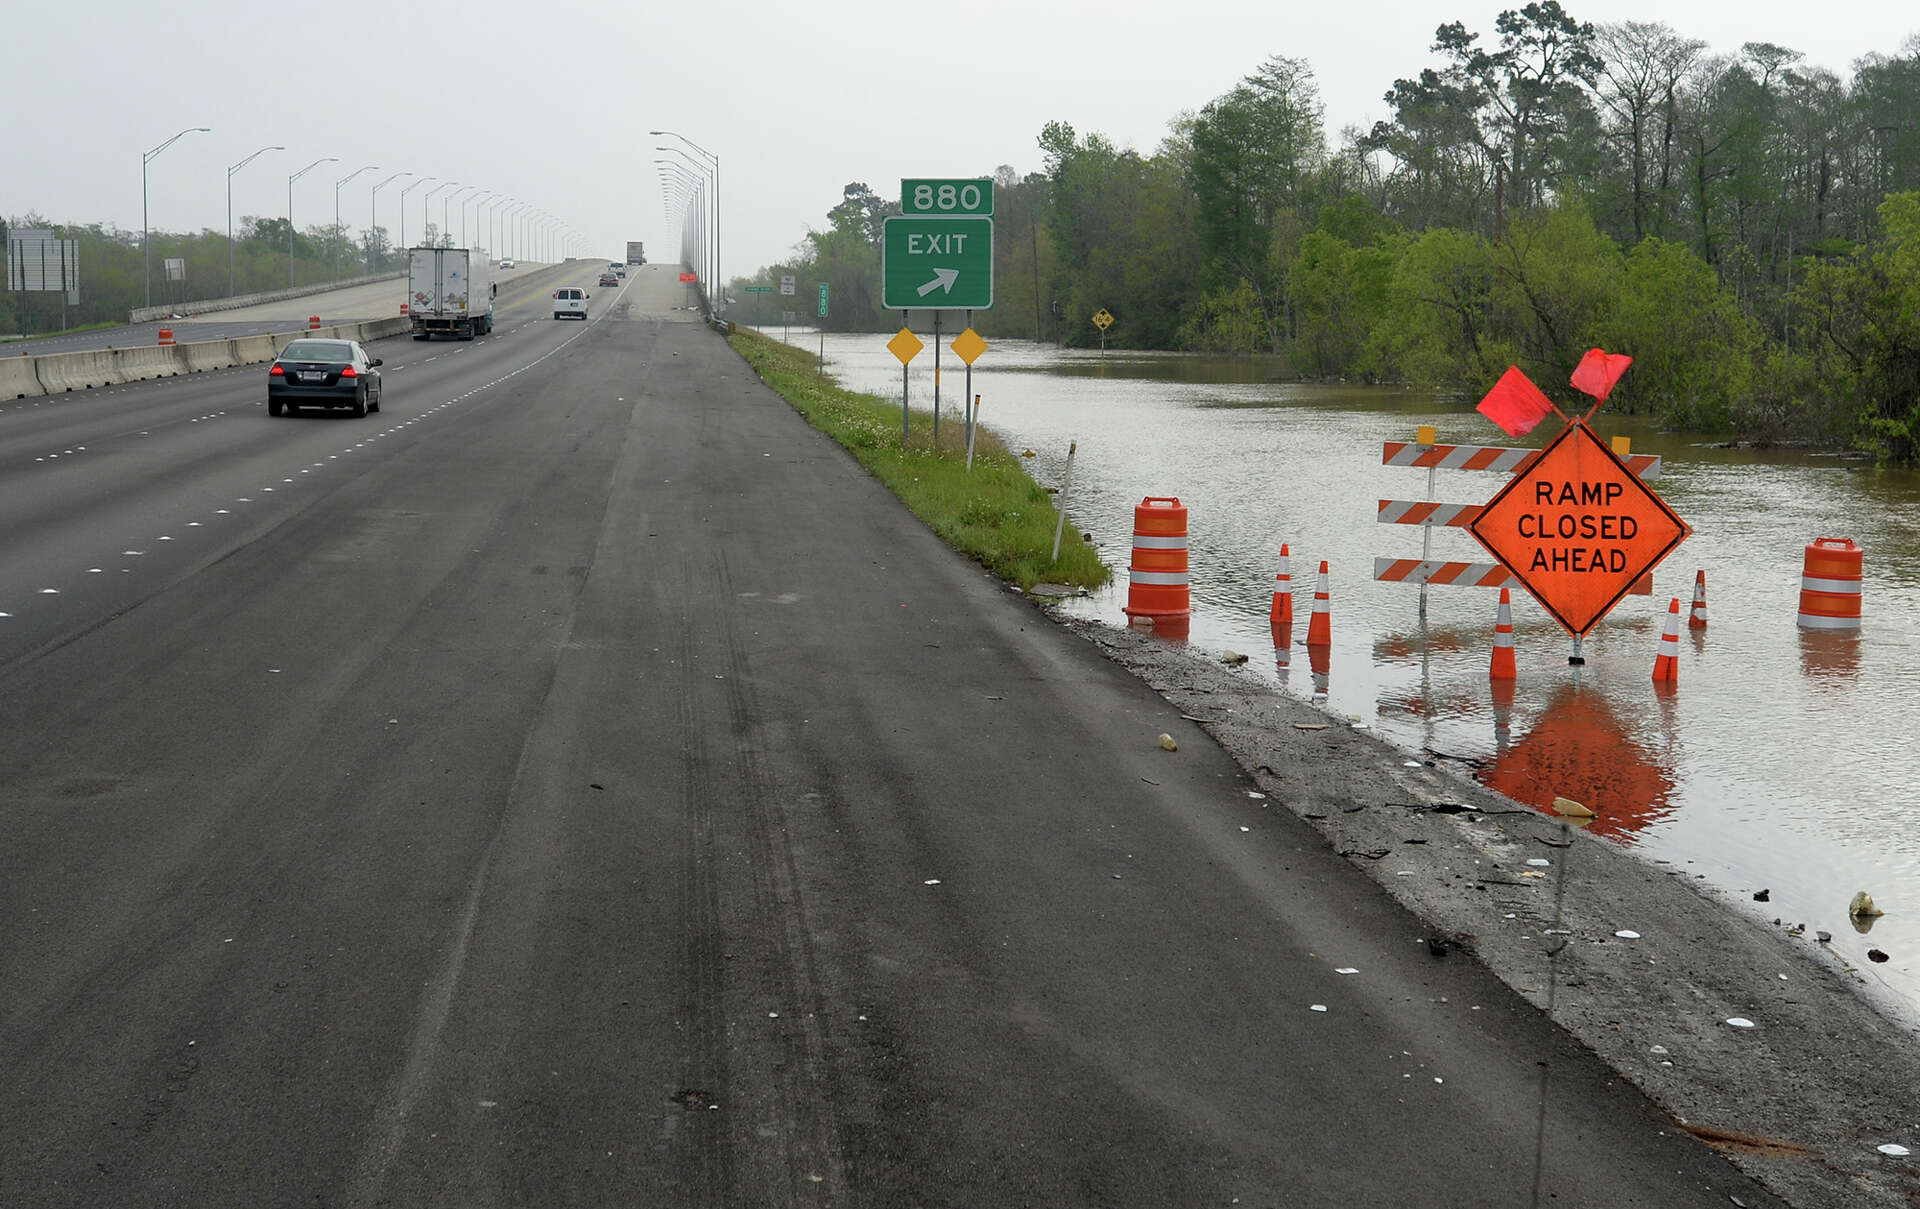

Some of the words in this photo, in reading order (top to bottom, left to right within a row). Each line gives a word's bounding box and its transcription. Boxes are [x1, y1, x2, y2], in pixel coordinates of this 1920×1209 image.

[913, 184, 981, 210] 880
[908, 234, 968, 254] EXIT
[1535, 481, 1623, 506] RAMP
[1518, 514, 1638, 540] CLOSED
[1528, 547, 1627, 573] AHEAD
